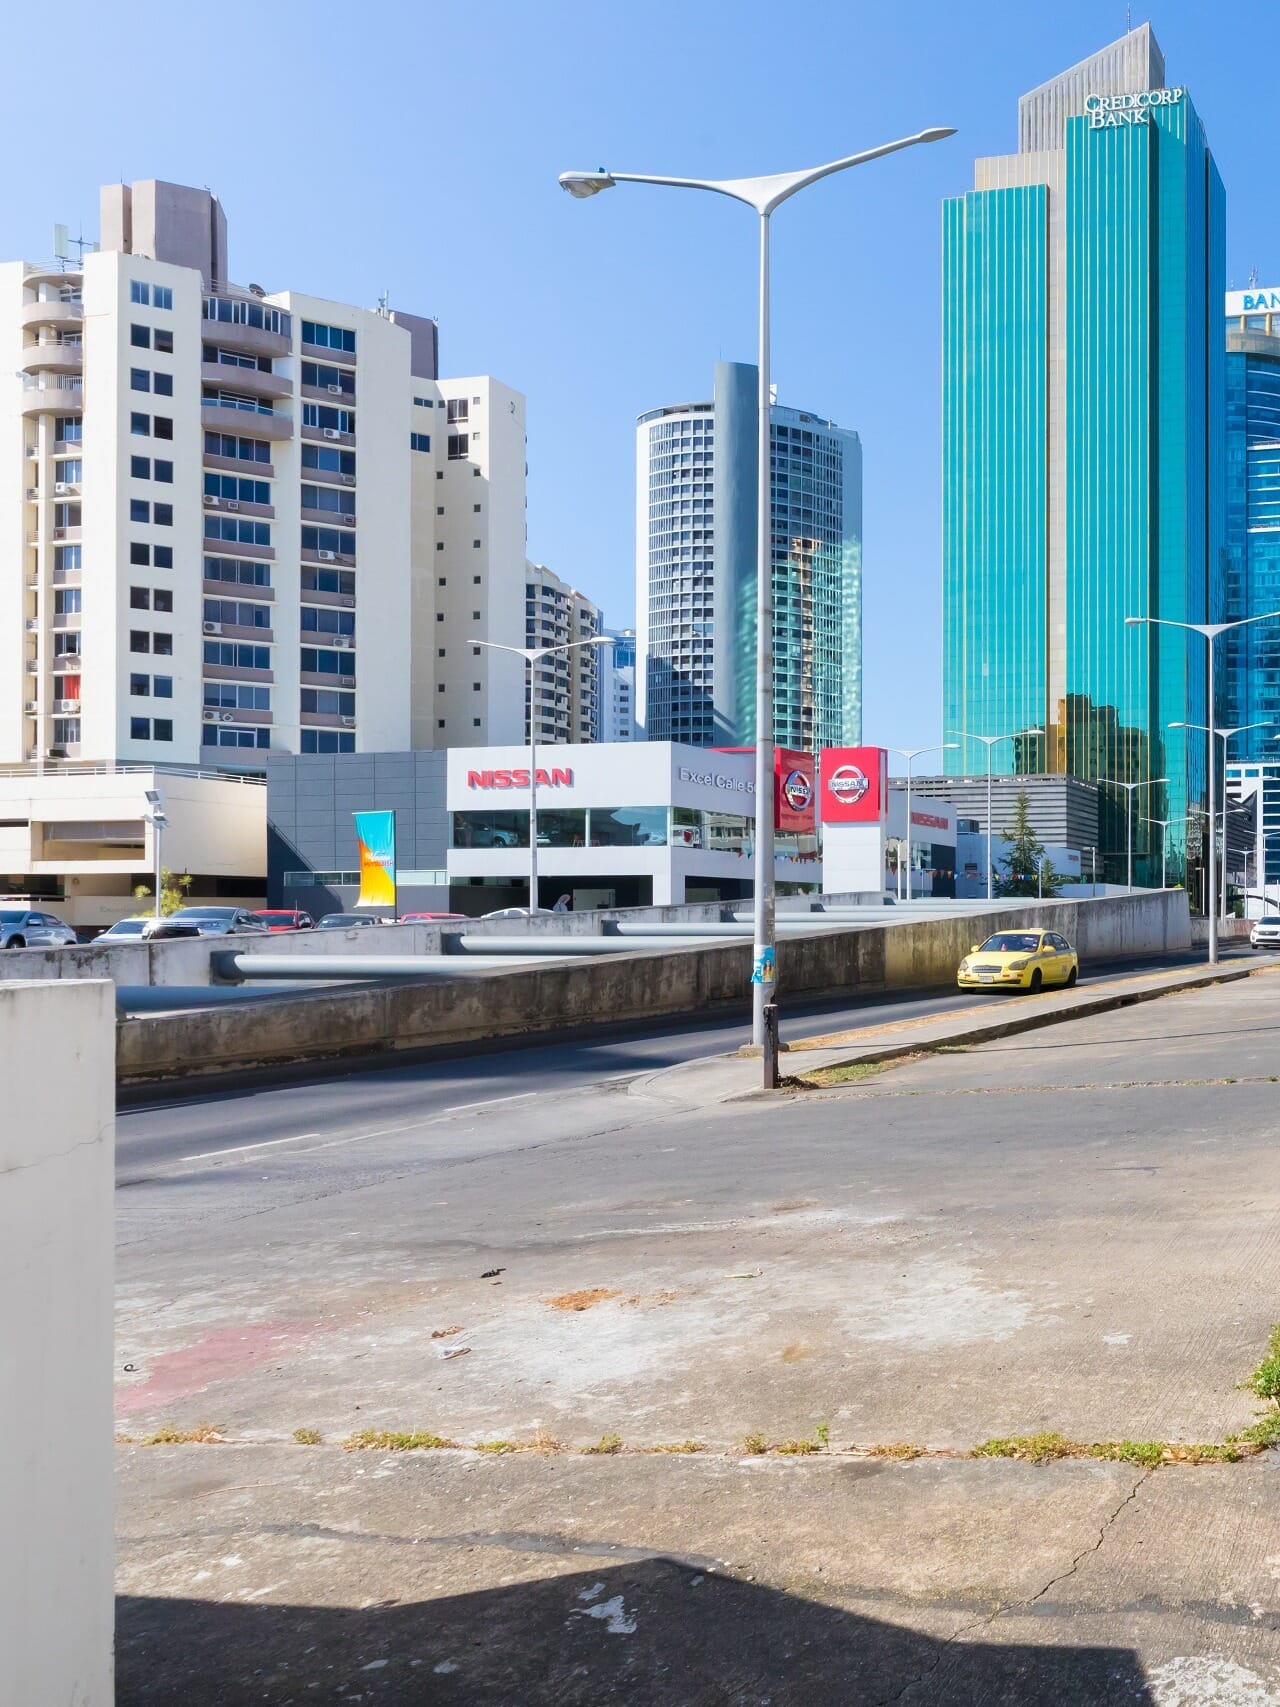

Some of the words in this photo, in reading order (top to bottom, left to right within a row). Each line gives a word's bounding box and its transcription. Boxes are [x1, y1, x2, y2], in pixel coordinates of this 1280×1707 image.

[1085, 88, 1183, 113] CREDICORP
[1089, 108, 1148, 129] BANK
[467, 768, 573, 789] NISSAN
[679, 767, 714, 786] Excel
[715, 775, 745, 792] Calle
[831, 779, 865, 788] NISSAN
